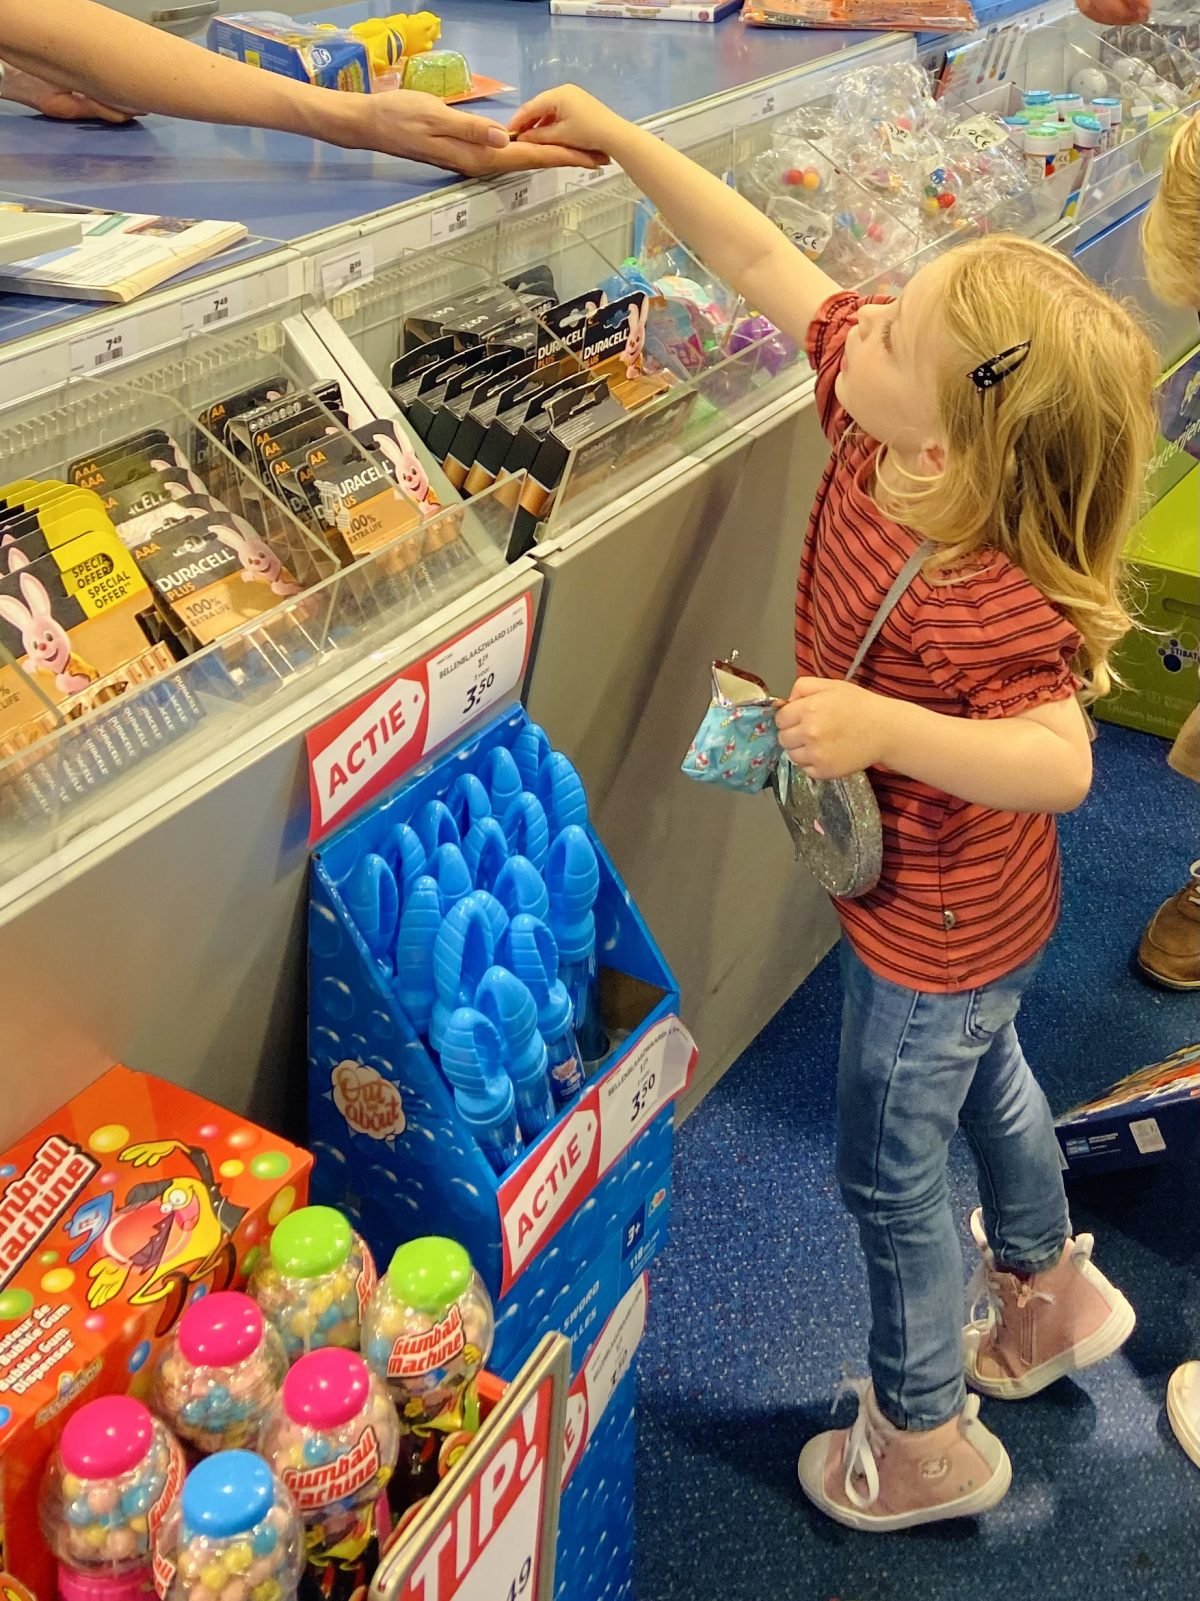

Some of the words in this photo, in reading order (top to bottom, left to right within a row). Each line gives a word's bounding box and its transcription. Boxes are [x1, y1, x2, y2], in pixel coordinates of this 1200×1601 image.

[583, 328, 630, 360] DURACELL
[275, 461, 291, 475] AA
[310, 451, 327, 466] AA
[339, 459, 393, 498] URACELL
[134, 542, 161, 560] AAA
[155, 547, 236, 592] DURACELL
[87, 571, 130, 599] SPECIAL
[169, 582, 196, 602] PLUS
[190, 611, 214, 627] EXTRA
[329, 701, 406, 798] ACTIE
[517, 1135, 582, 1247] ACTIE
[33, 1304, 51, 1321] de
[40, 1303, 71, 1329] Gum
[38, 1327, 70, 1353] Gum
[11, 1338, 75, 1395] Dispenser
